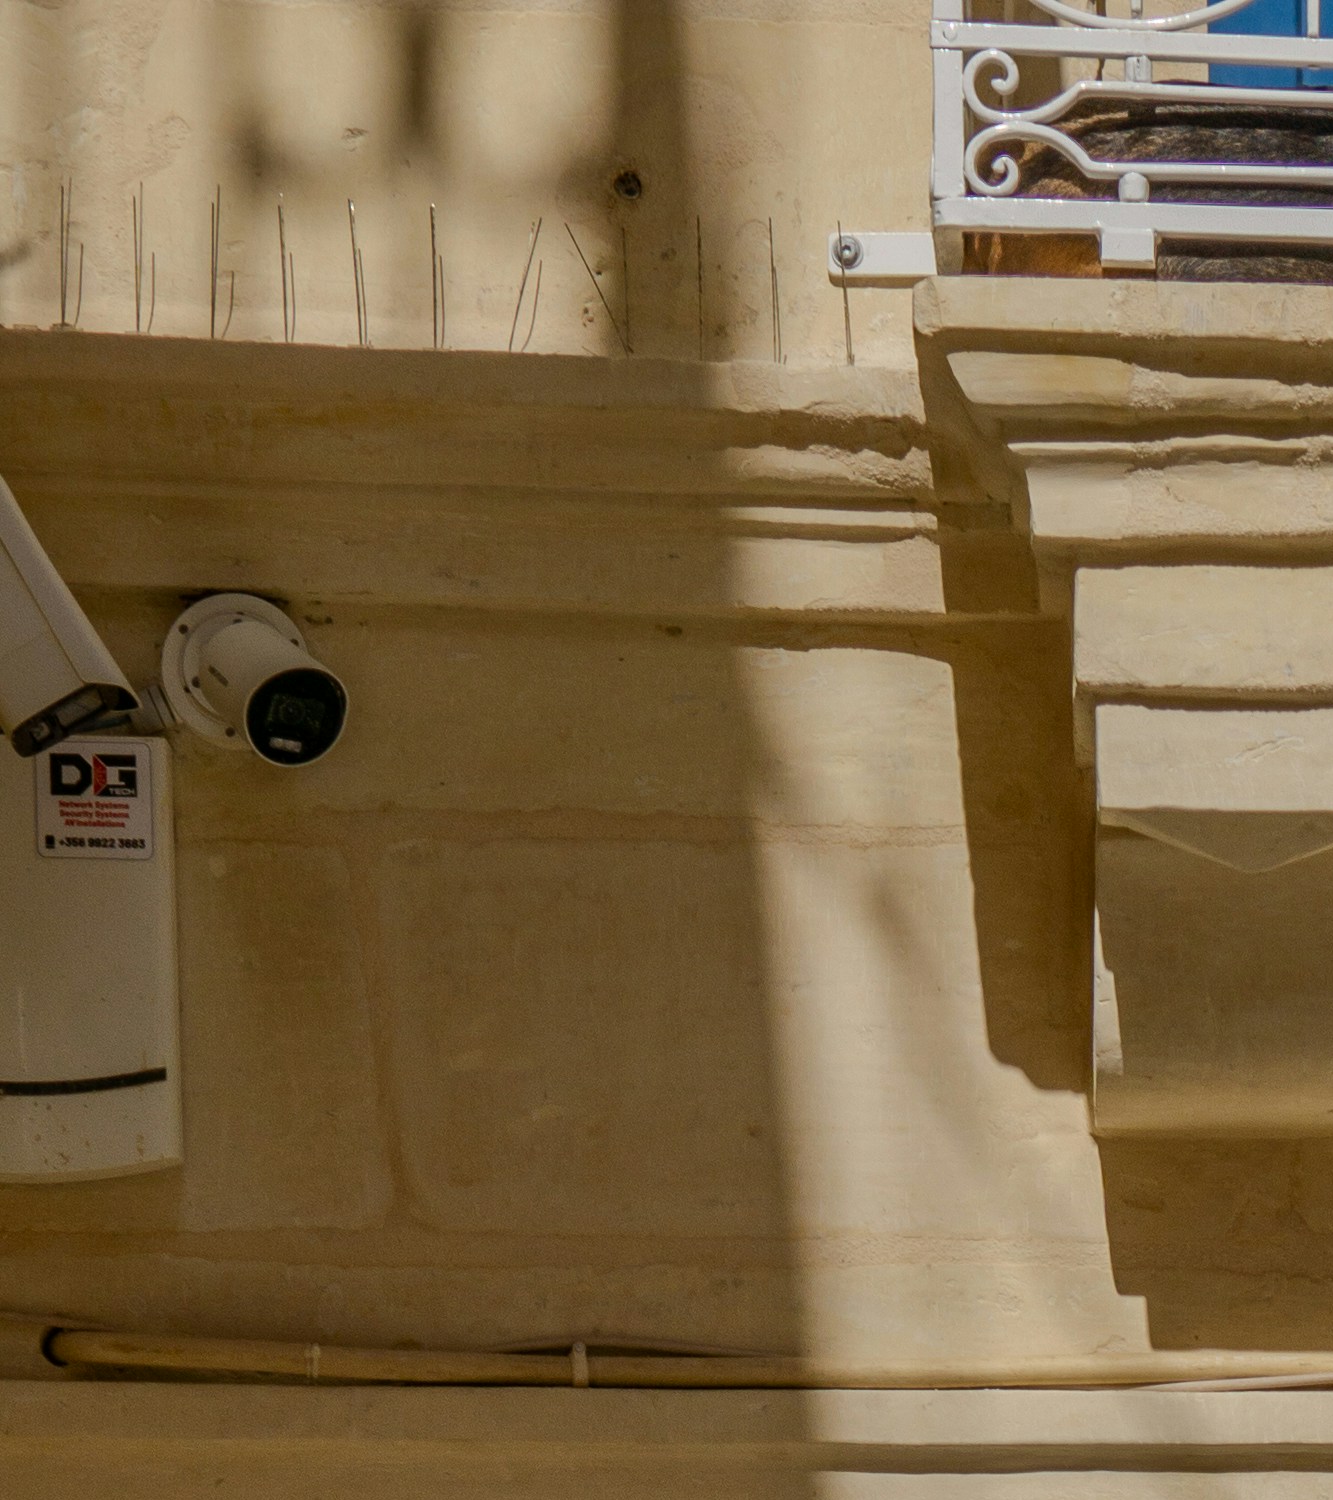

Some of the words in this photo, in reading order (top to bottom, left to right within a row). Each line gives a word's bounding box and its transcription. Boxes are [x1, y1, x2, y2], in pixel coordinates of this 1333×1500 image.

[109, 787, 136, 796] TECH
[58, 800, 93, 808] Network
[95, 801, 130, 810] Systems
[59, 809, 93, 818] Security
[95, 810, 130, 819] Systems
